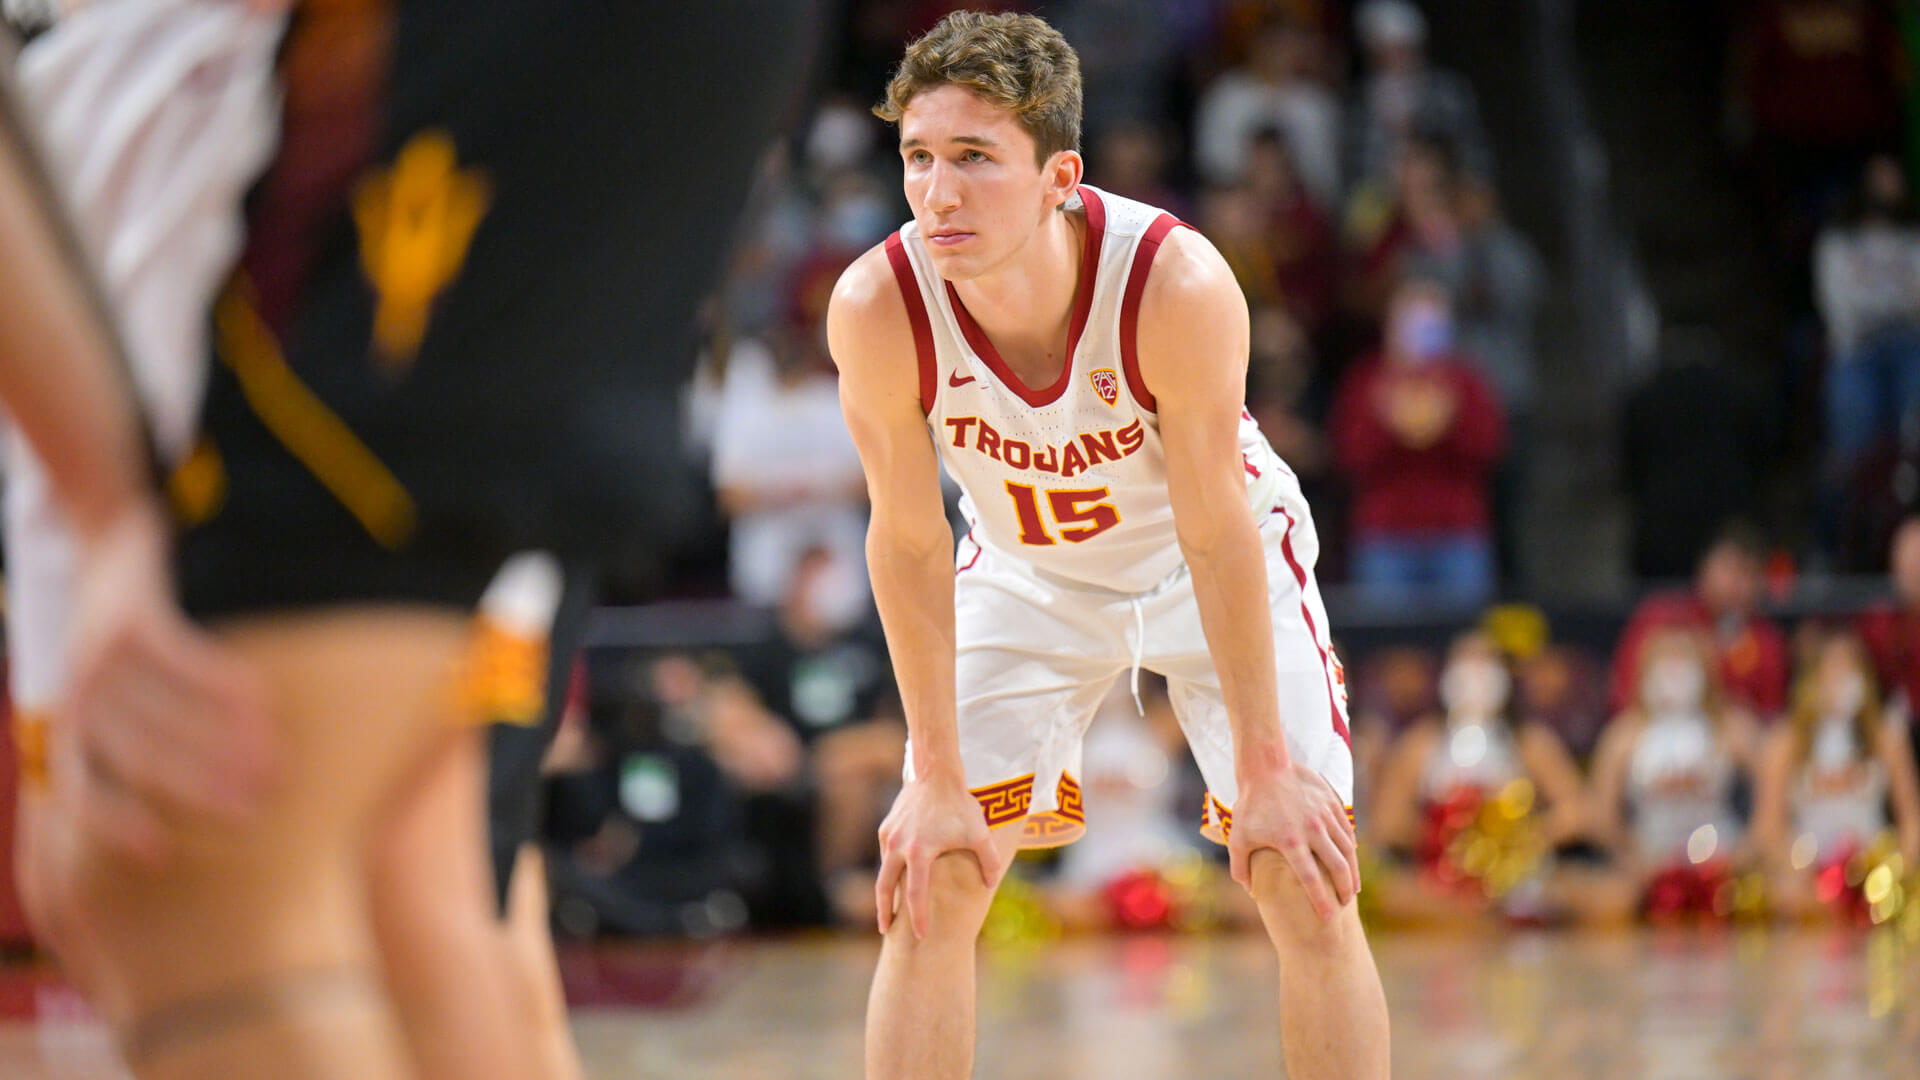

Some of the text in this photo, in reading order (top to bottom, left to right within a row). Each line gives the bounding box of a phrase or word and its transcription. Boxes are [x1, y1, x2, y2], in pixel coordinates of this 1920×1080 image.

[1092, 371, 1116, 392] PAC
[1101, 386, 1115, 399] 12
[945, 416, 1145, 477] TROJANS
[1004, 480, 1122, 545] 15
